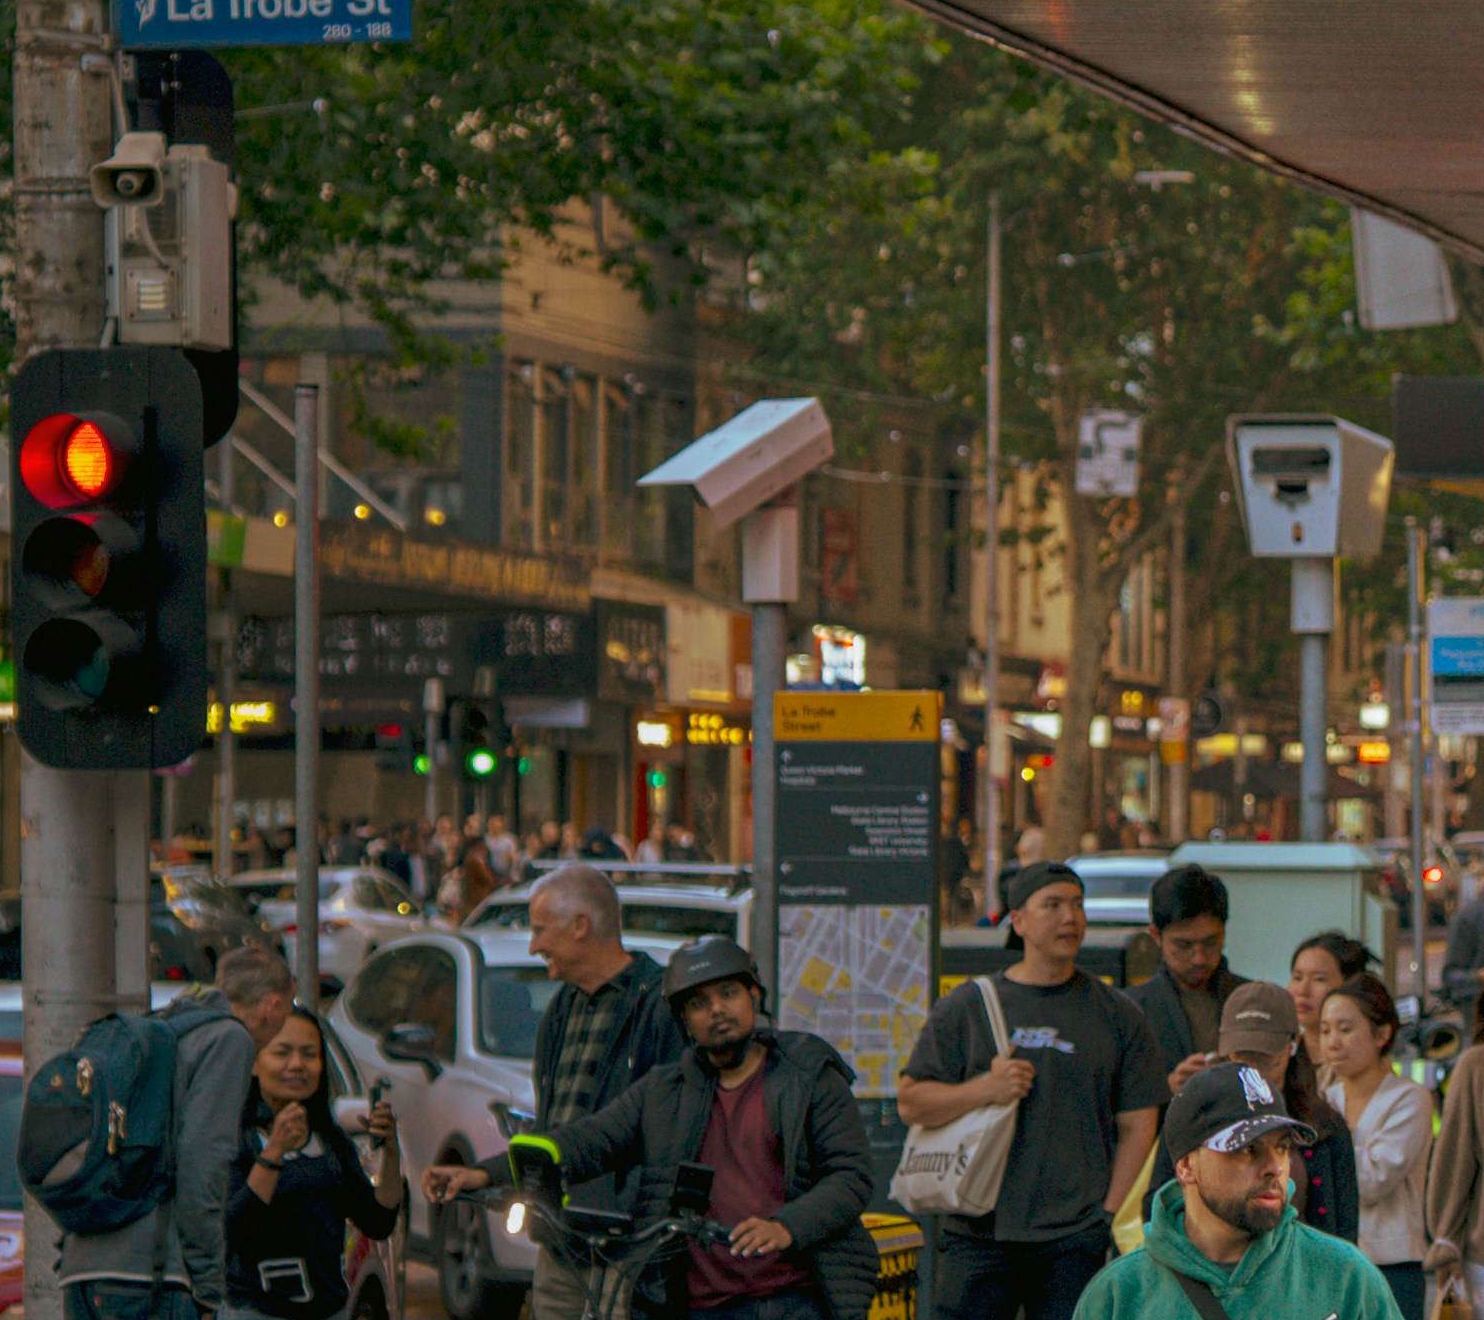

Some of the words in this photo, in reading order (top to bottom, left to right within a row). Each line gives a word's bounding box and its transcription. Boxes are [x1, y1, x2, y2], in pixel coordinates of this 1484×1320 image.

[322, 24, 352, 39] 280
[781, 705, 797, 718] La
[802, 704, 836, 718] Trobe
[781, 719, 822, 732] Street
